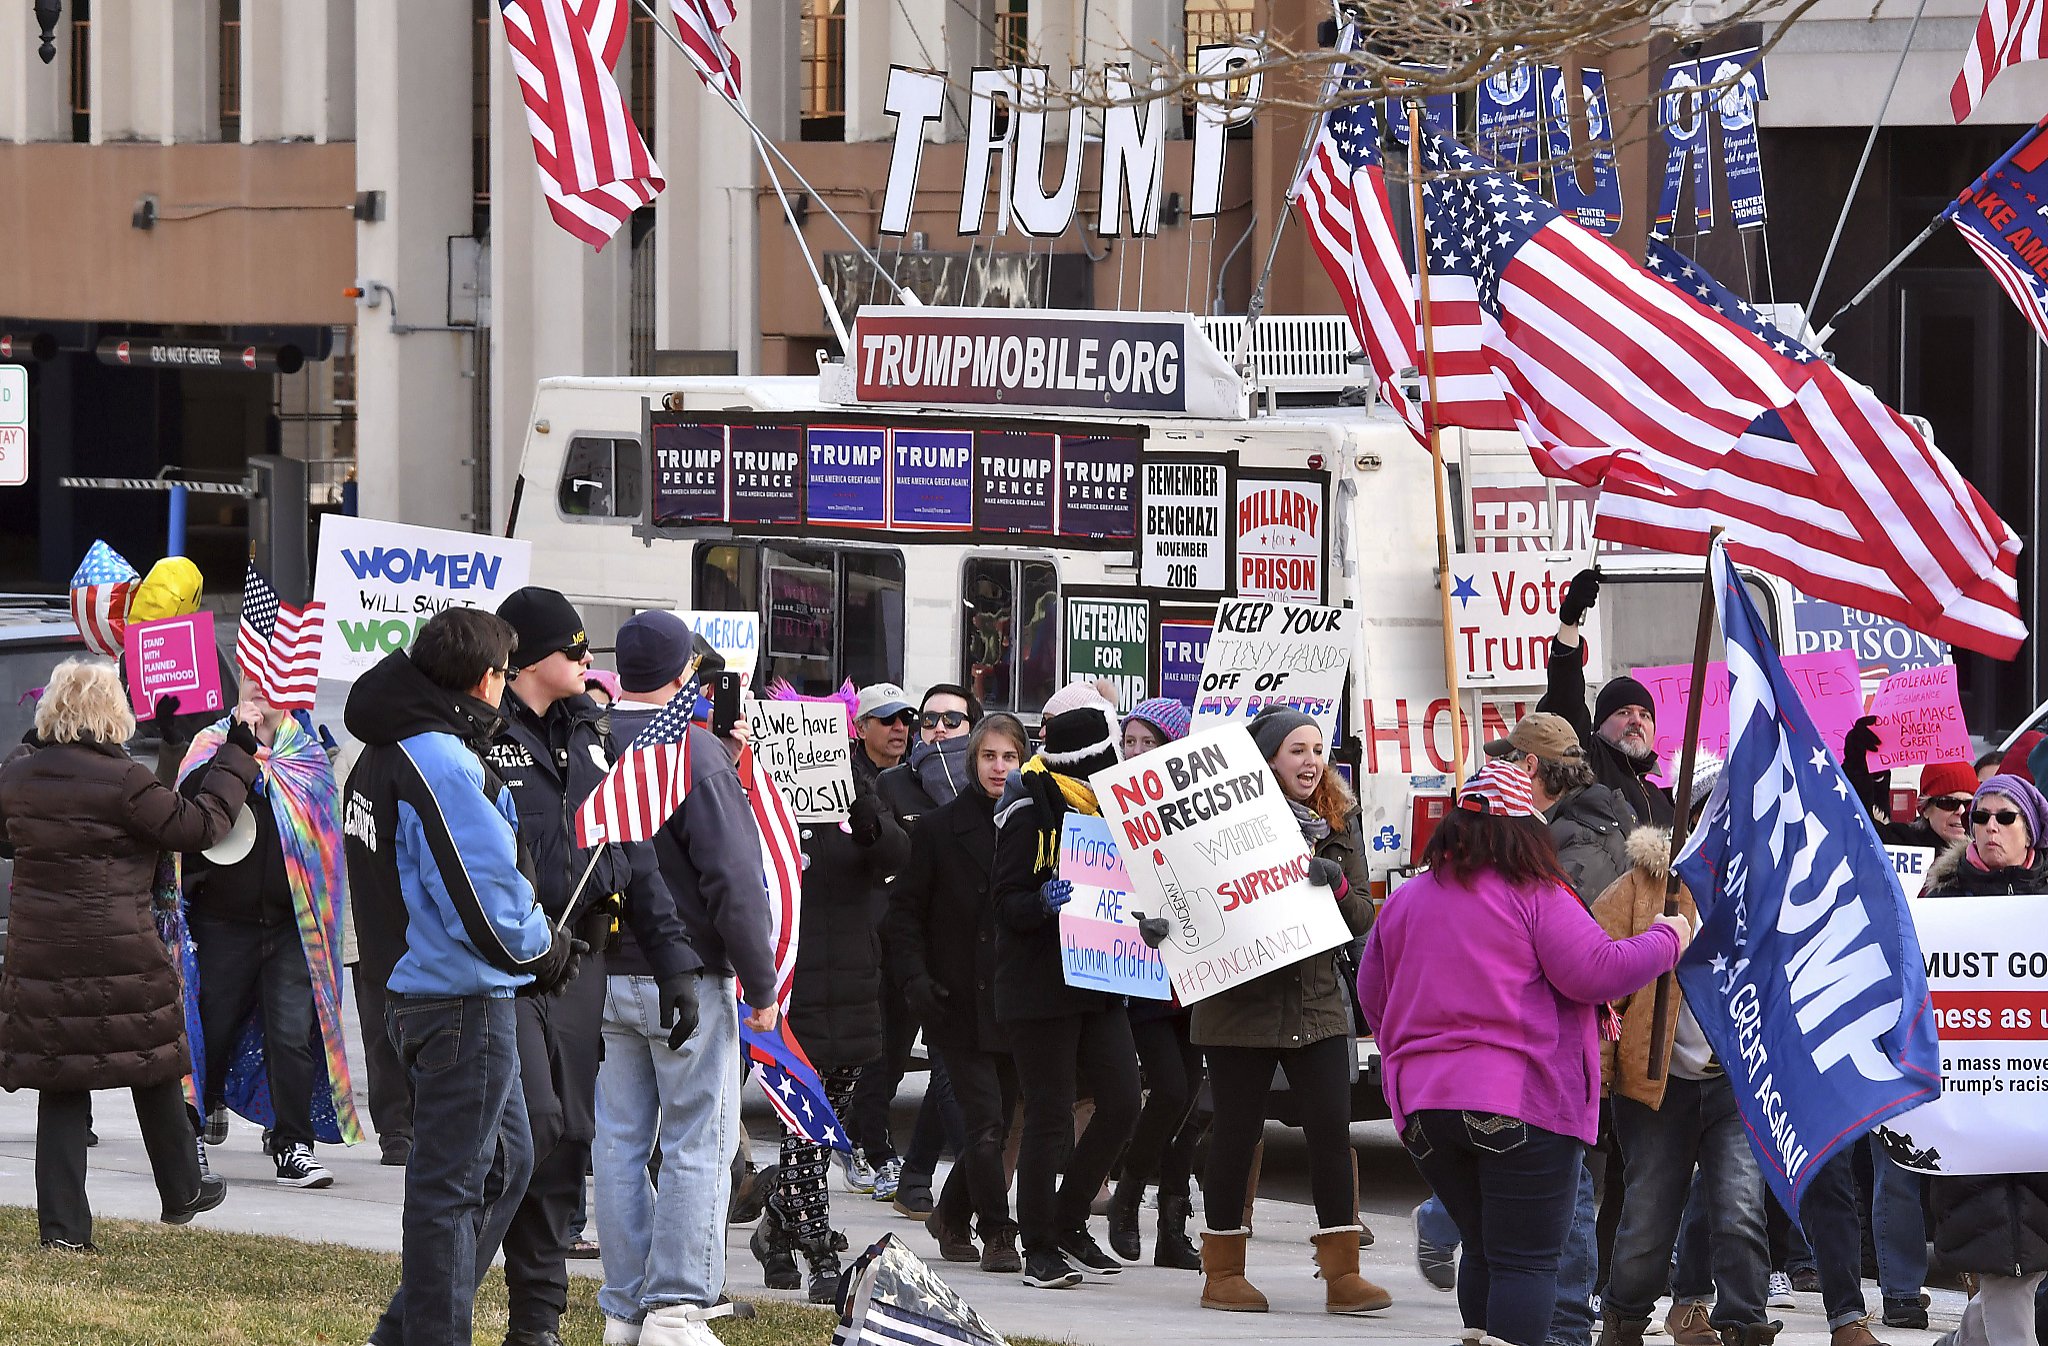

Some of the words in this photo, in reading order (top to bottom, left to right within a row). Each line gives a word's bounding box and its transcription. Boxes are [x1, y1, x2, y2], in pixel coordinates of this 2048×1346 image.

[879, 43, 1265, 239] TRUMP
[1577, 207, 1605, 217] CENTEX
[1732, 195, 1763, 209] CENTEX
[1736, 206, 1763, 219] HOMES
[1580, 216, 1605, 227] HOMES
[152, 346, 166, 362] DO
[168, 346, 188, 363] NOT
[190, 347, 221, 365] ENTER
[863, 334, 1179, 395] TRUMPMOBILE.ORG
[657, 449, 722, 469] TRUMP
[733, 451, 798, 471] TRUMP
[811, 445, 882, 466] TRUMP
[897, 446, 969, 468] TRUMP
[663, 472, 715, 485] PENCE
[810, 474, 824, 483] MAKE
[825, 475, 847, 484] AMERICA
[847, 476, 863, 484] GREAT
[864, 476, 881, 484] AGAIN!
[981, 457, 1051, 479] TRUMP
[1064, 461, 1134, 483] TRUMP
[738, 474, 792, 487] PENCE
[897, 476, 911, 485] MAKE
[911, 477, 933, 486] AMERICA
[934, 478, 950, 486] GREAT
[951, 478, 969, 487] AGAIN!
[986, 480, 1044, 495] PENCE
[1148, 465, 1218, 497] REMEMBER
[1069, 485, 1127, 500] PENCE
[1147, 505, 1218, 537] BENGHAZI
[1239, 489, 1319, 539] HILLARY
[1156, 541, 1208, 558] NOVEMBER
[1272, 529, 1286, 550] for
[341, 546, 502, 590] WOMEN
[1167, 564, 1197, 588] 2016
[1242, 557, 1315, 591] PRISON
[360, 590, 409, 613] WILL
[1071, 603, 1146, 644] VETERANS
[1218, 602, 1274, 633] KEEP
[1280, 606, 1342, 634] YOUR
[144, 637, 165, 649] STAND
[1796, 627, 1942, 660] PRISON
[144, 650, 160, 660] WITH
[144, 660, 176, 672] PLANNED
[1094, 646, 1122, 669] FOR
[1218, 639, 1280, 671] TINY
[1278, 643, 1348, 671] HANDS
[145, 669, 194, 685] PARENTHOOD
[1164, 673, 1179, 681] MAKE
[1203, 672, 1241, 691] OFF
[1254, 672, 1289, 692] OF
[1199, 695, 1242, 717] MY
[1875, 715, 1890, 727] DO
[1891, 710, 1915, 725] NOT
[1919, 705, 1956, 722] MAKE
[1900, 723, 1941, 736] AMERICA
[1900, 735, 1940, 748] GREAT!
[766, 742, 784, 766] To
[787, 737, 846, 774] Redeem
[1879, 750, 1928, 765] DIVERSITY
[1111, 769, 1164, 815] NO
[1165, 743, 1229, 791] BAN
[1122, 810, 1162, 851] NO
[1156, 769, 1264, 836] REGISTRY
[1069, 827, 1117, 871] Trans
[1193, 814, 1278, 866] WHITE
[1096, 888, 1126, 924] ARE
[1165, 883, 1200, 947] CONDEMN
[1067, 933, 1109, 975] Human
[2000, 1008, 2032, 1029] as
[1729, 983, 1768, 1084] GREAT
[1943, 1058, 1951, 1071] a
[1957, 1058, 2001, 1071] mass
[1754, 1073, 1809, 1185] AGAIN!
